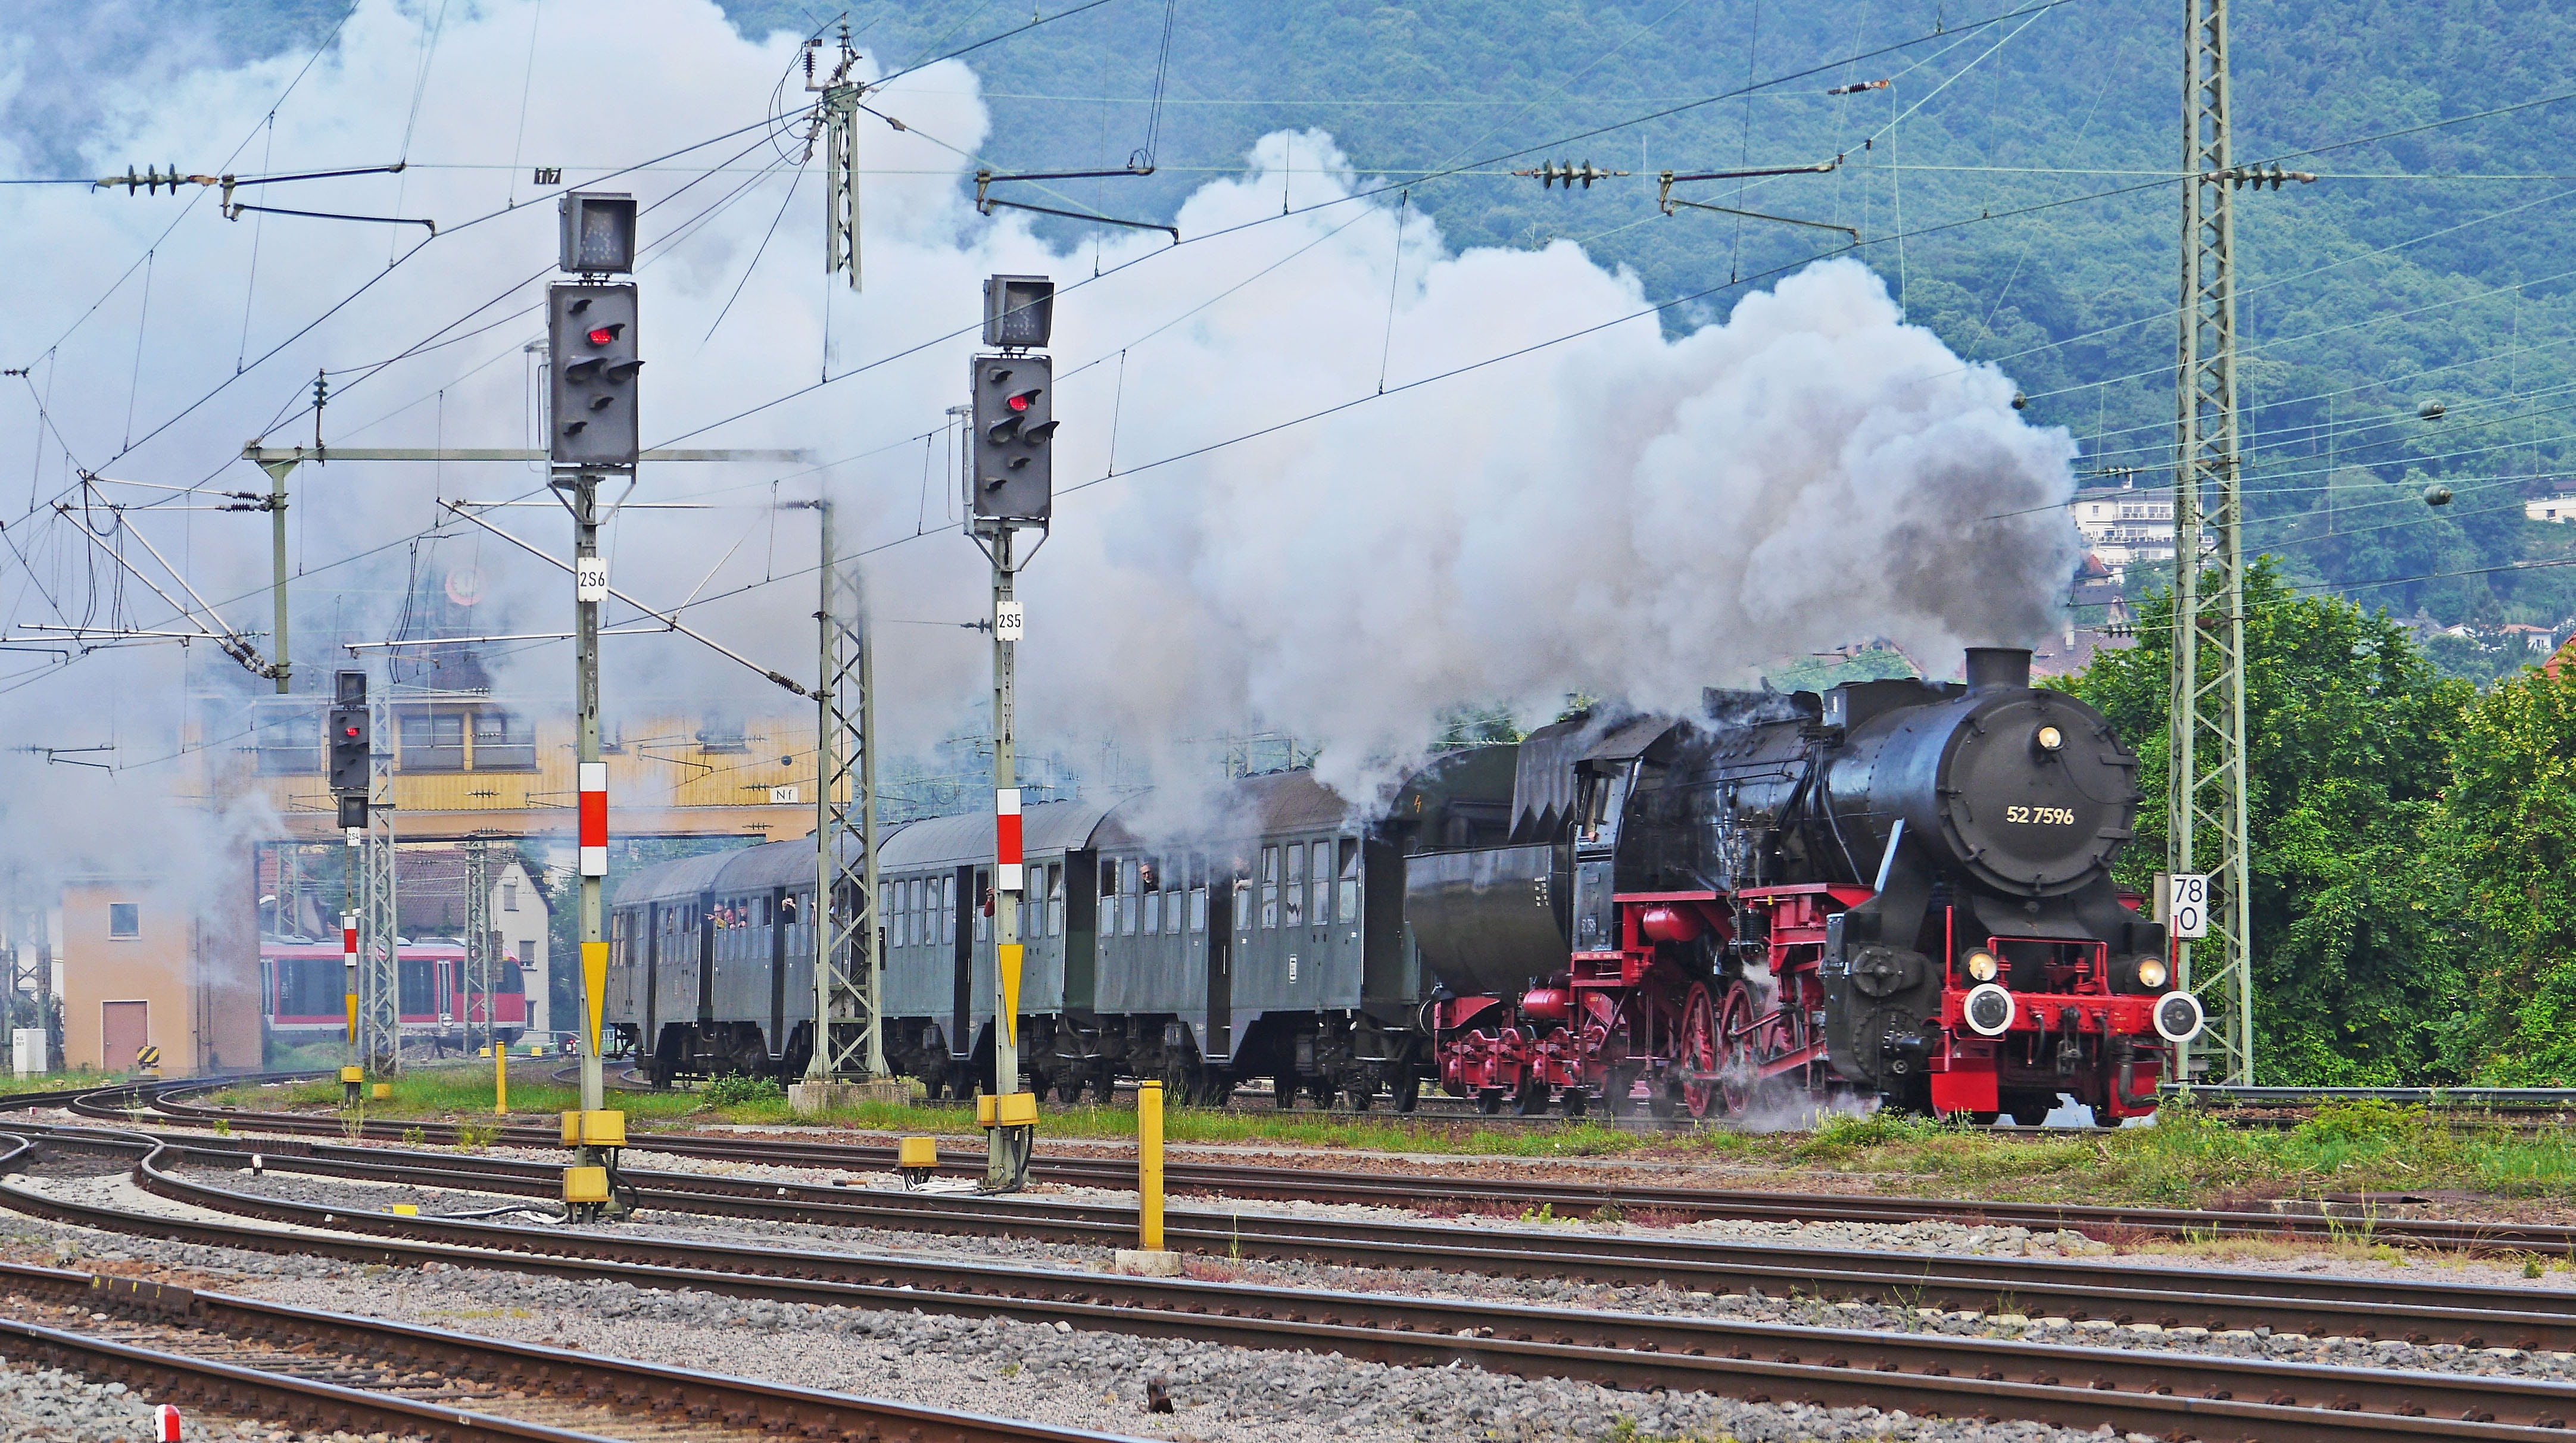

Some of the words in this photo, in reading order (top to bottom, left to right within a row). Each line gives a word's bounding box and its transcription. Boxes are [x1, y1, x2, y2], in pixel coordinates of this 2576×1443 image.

[537, 170, 559, 183] 17
[580, 571, 605, 587] 2S6
[999, 614, 1021, 628] 2S5
[776, 789, 793, 801] Nf
[2006, 805, 2030, 823] 52
[2032, 807, 2075, 825] 7596
[2174, 878, 2203, 903] 78
[2179, 906, 2198, 930] 0
